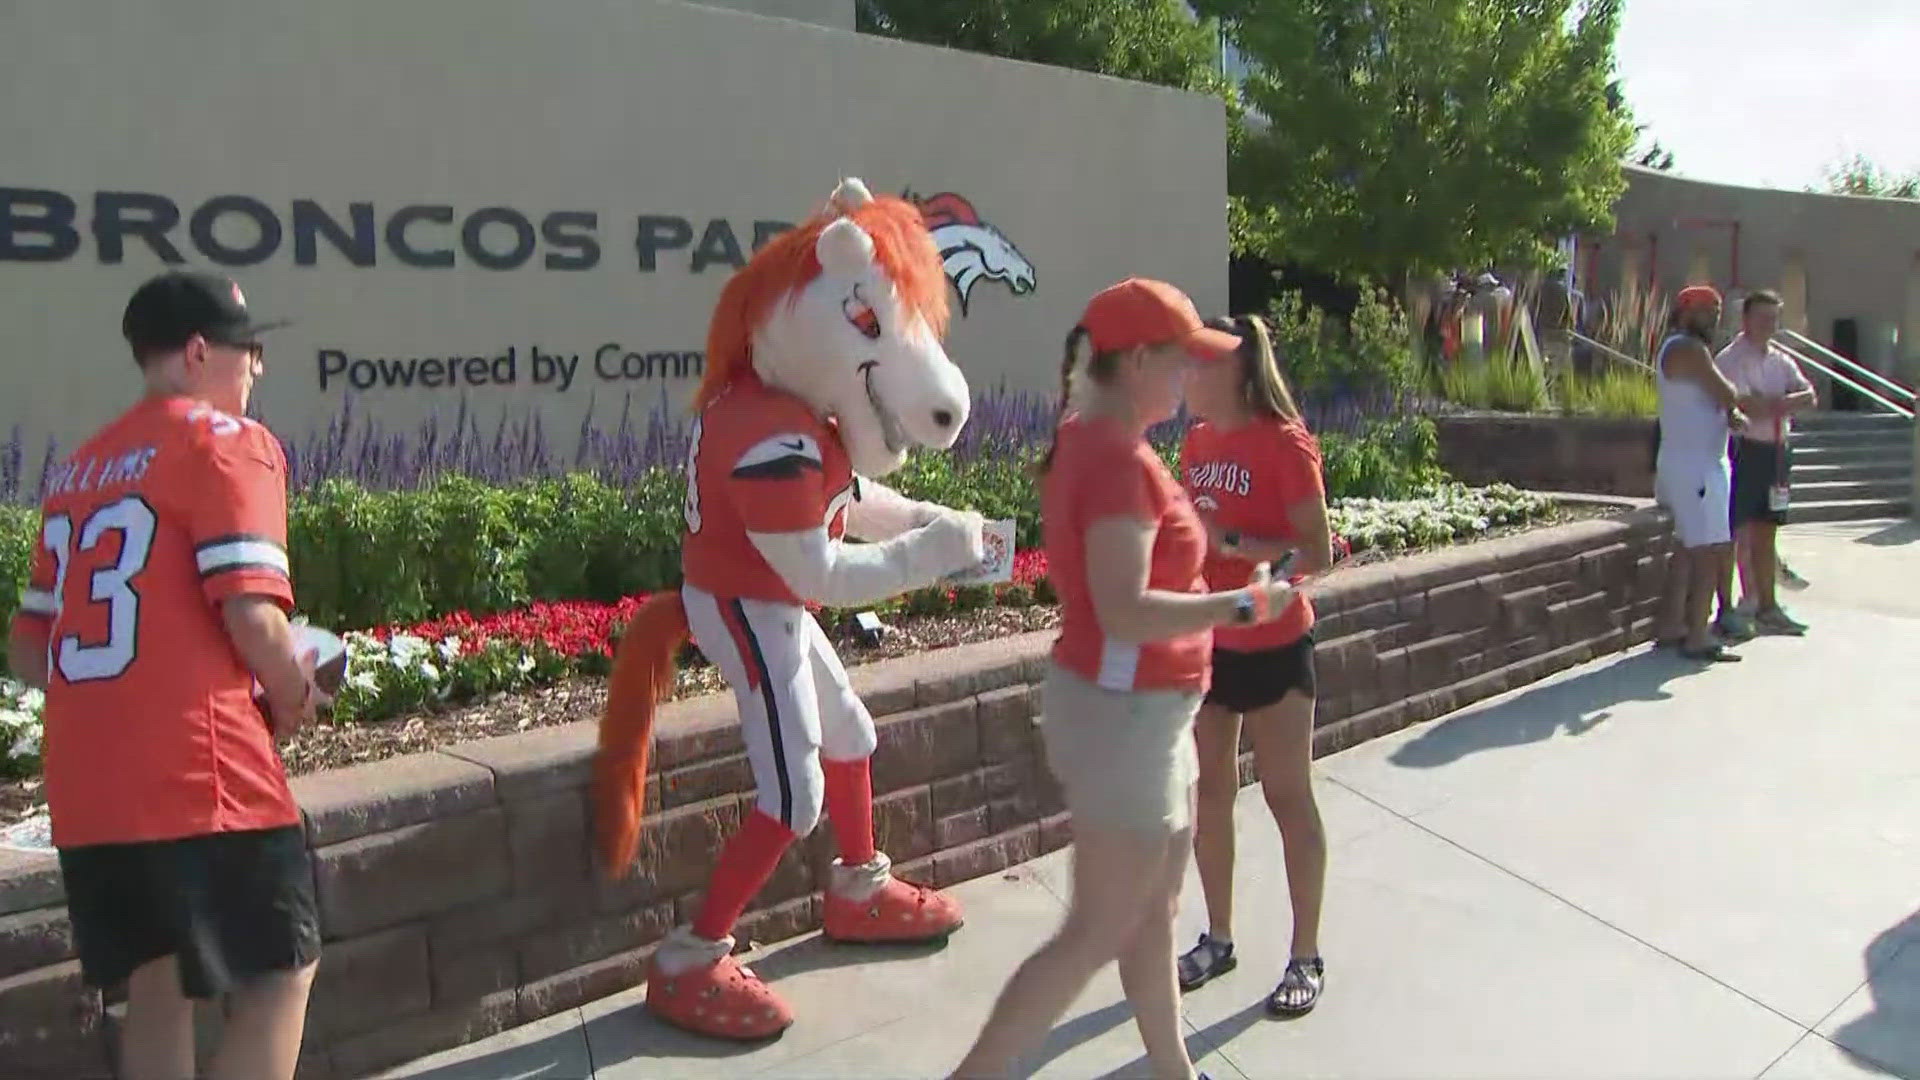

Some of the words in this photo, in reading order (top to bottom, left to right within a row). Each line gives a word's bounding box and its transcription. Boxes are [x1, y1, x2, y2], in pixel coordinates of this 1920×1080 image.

[0, 187, 600, 270] BRONCOS
[318, 346, 516, 392] Powered
[532, 346, 579, 392] by
